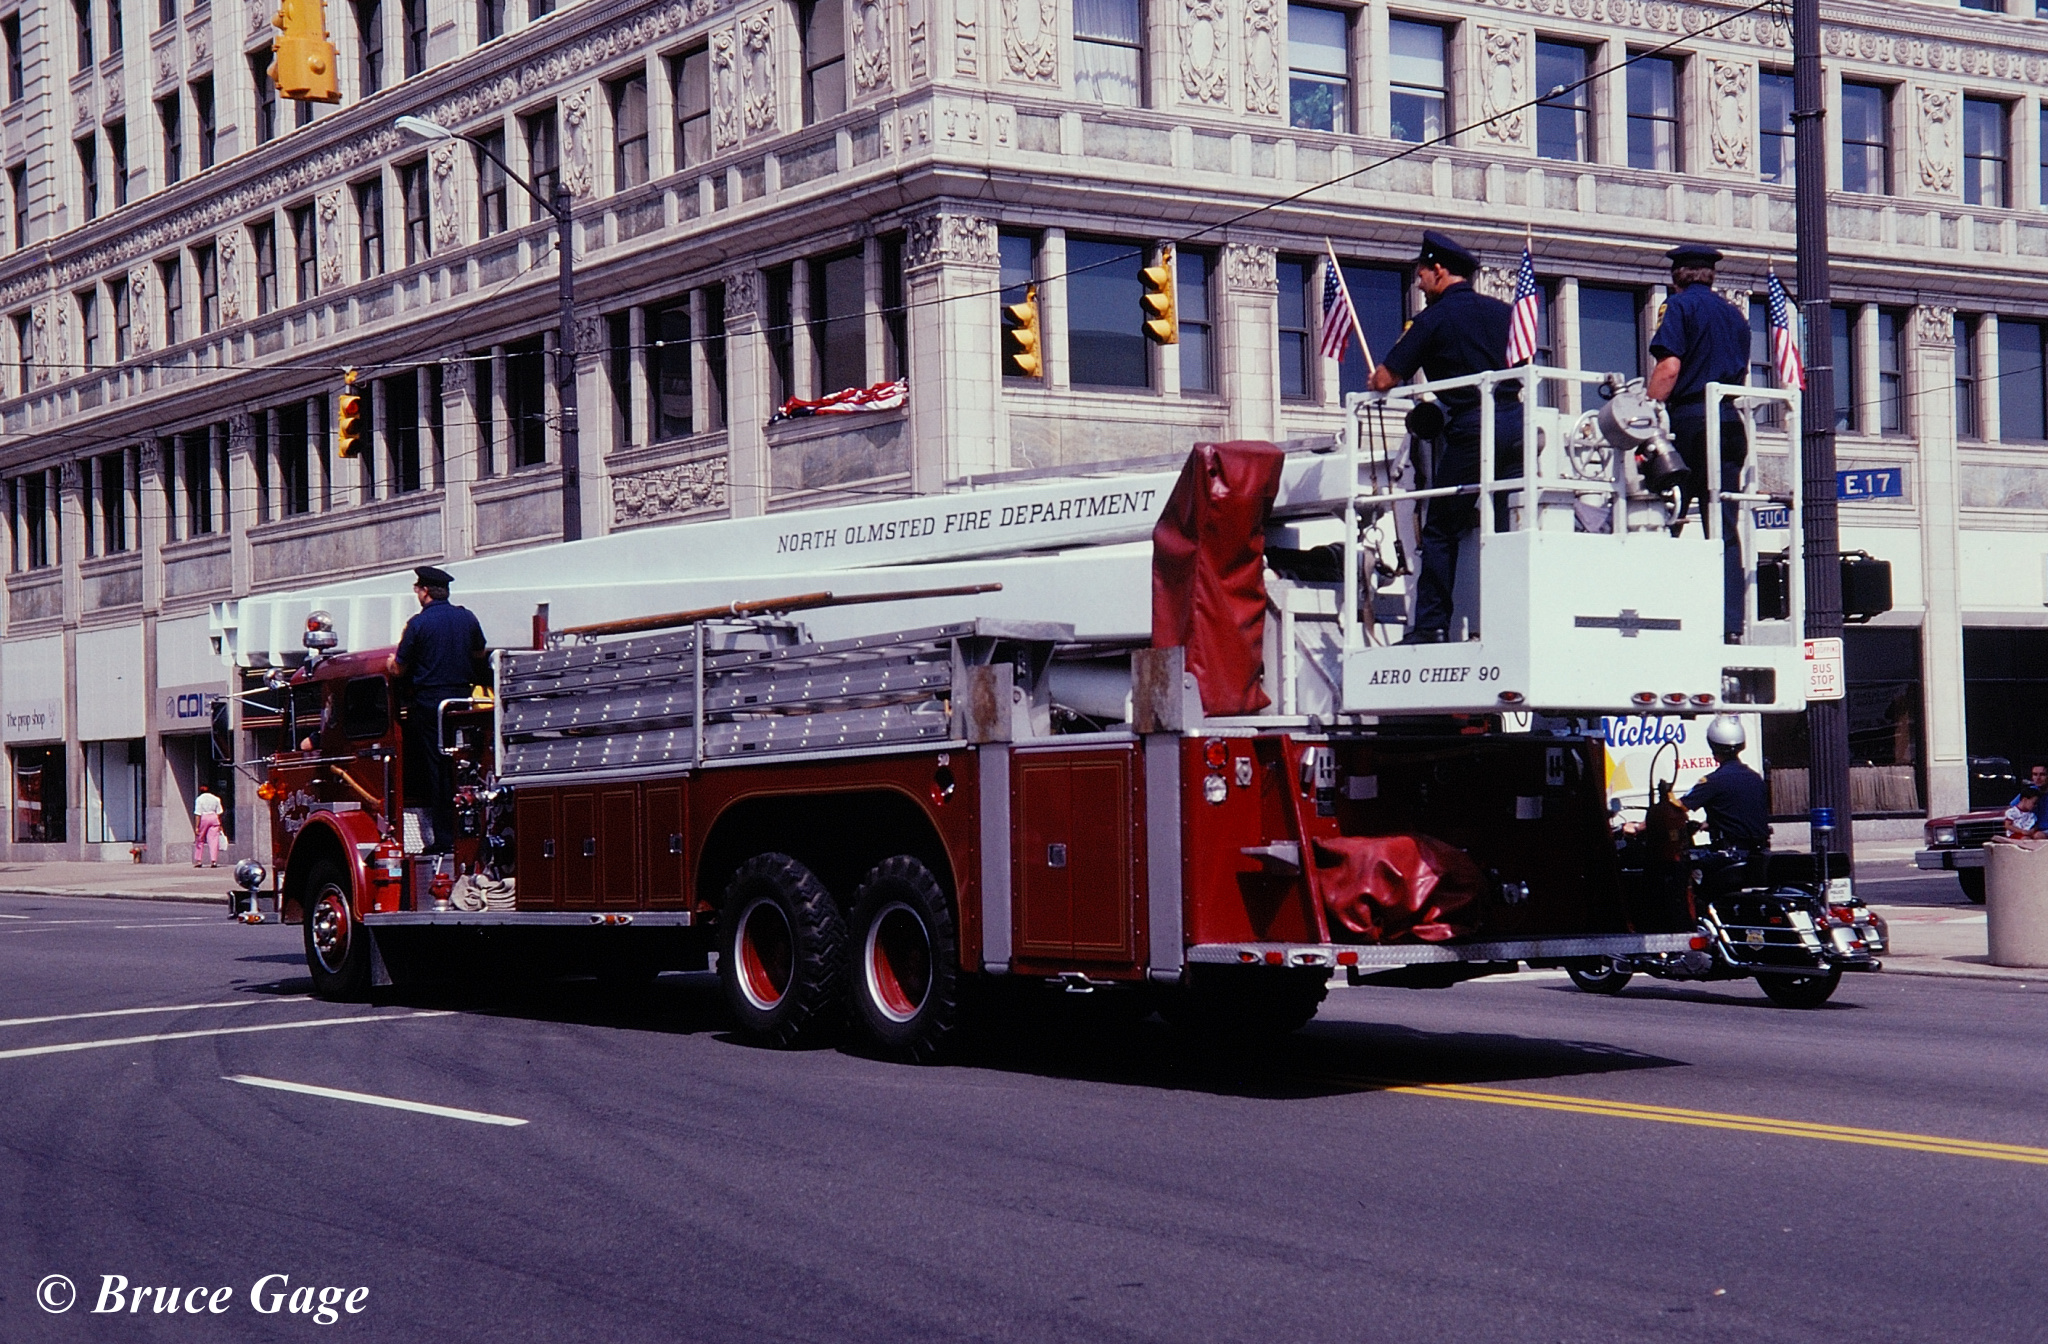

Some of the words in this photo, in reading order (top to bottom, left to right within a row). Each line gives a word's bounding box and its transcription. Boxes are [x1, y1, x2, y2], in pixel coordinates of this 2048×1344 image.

[1866, 473, 1890, 493] 17
[777, 529, 837, 553] NORTH
[845, 517, 935, 545] OLMSTED
[944, 510, 991, 534] FIRE
[999, 490, 1155, 527] DEPARTMENT
[1758, 511, 1789, 527] EUCL
[1369, 669, 1411, 685] AERO
[1419, 667, 1471, 683] CHIEF
[1478, 666, 1500, 681] 90
[1812, 664, 1832, 674] BUS
[1811, 675, 1835, 686] STOP
[6, 711, 17, 728] The
[32, 709, 46, 730] shop
[1601, 716, 1686, 747] Nickles
